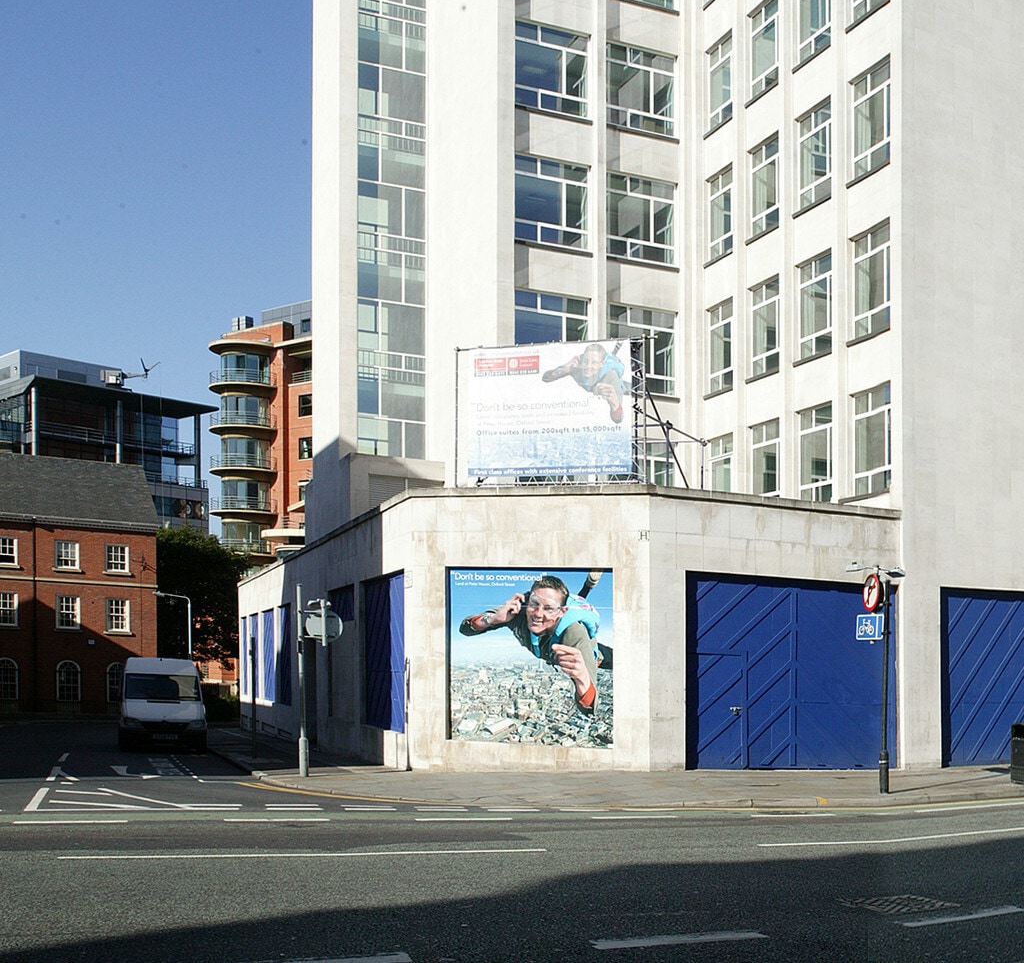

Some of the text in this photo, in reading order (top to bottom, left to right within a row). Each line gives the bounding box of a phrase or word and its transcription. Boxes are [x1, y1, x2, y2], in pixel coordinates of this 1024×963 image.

[503, 401, 515, 411] be
[517, 403, 529, 411] so
[499, 428, 520, 436] suites
[520, 427, 539, 435] from
[541, 427, 570, 435] 200sqft
[582, 425, 622, 433] 15,000sqft
[474, 572, 485, 581] be
